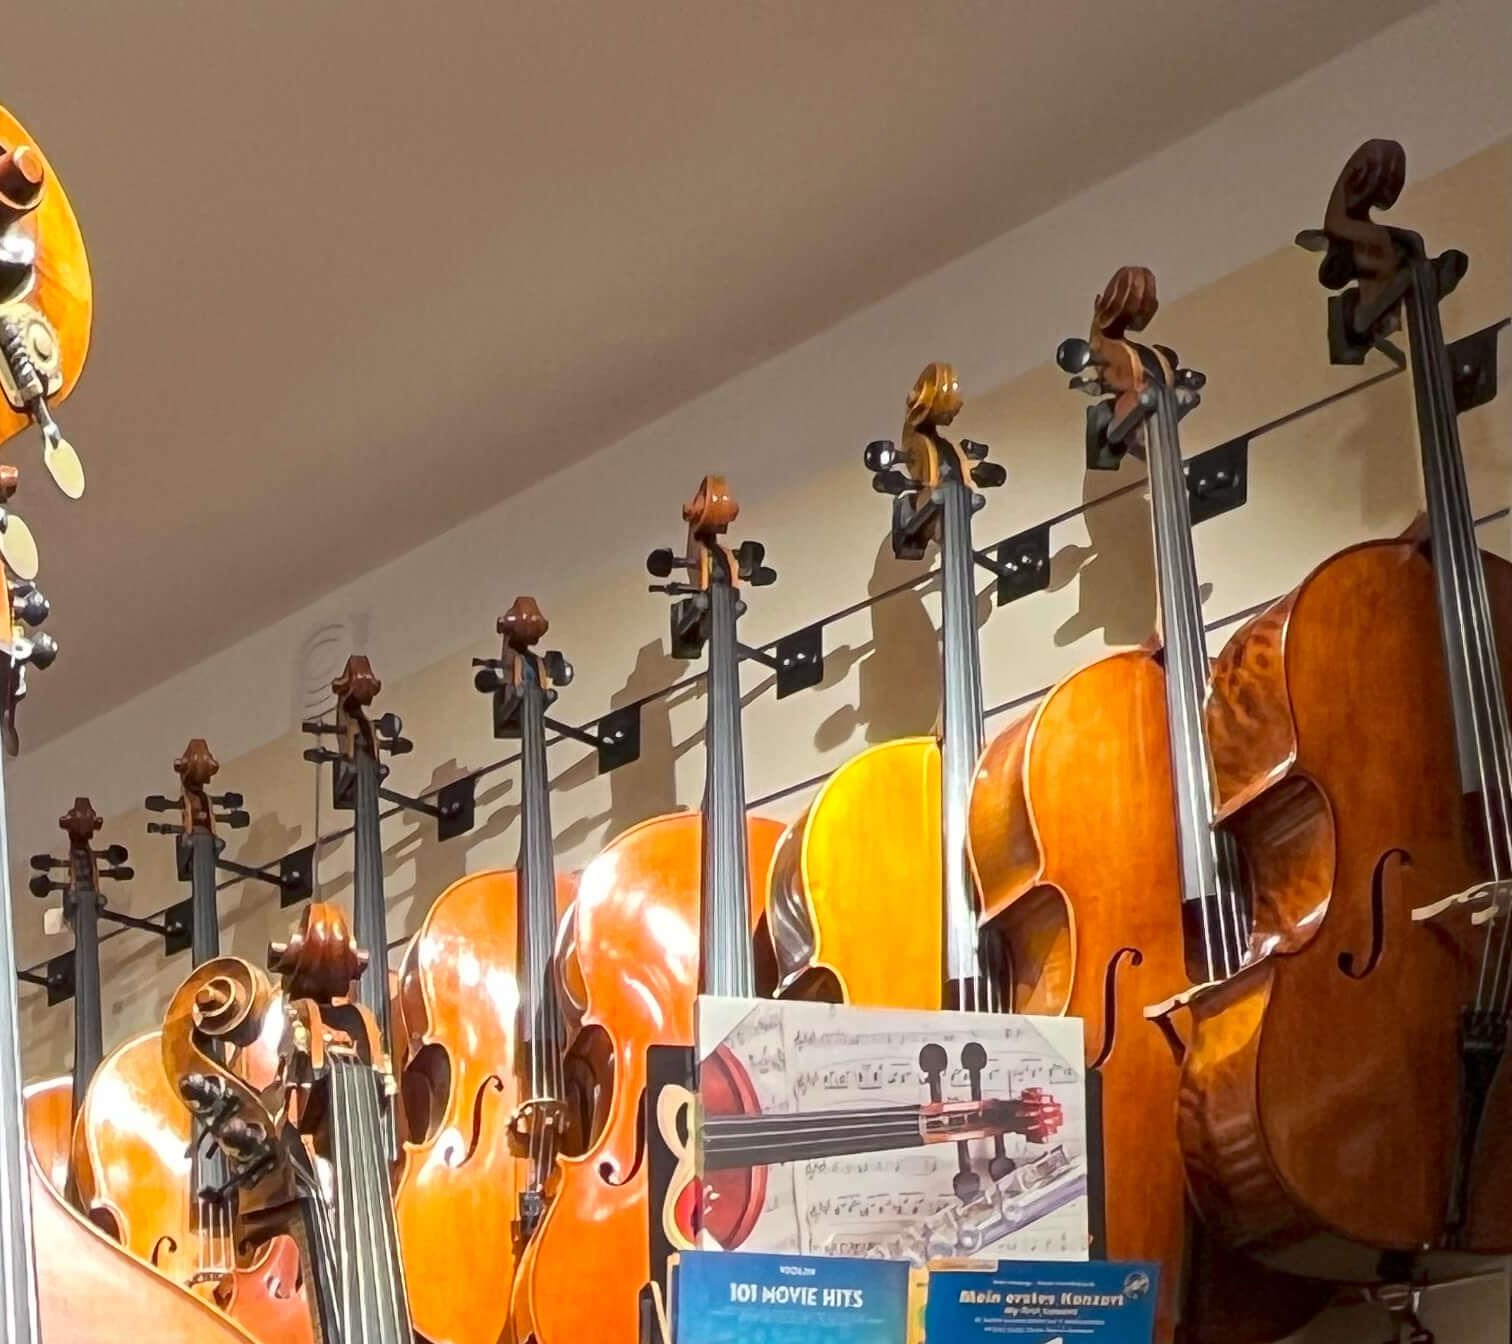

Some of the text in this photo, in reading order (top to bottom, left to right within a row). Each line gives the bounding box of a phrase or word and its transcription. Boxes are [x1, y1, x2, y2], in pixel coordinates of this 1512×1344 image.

[729, 1282, 863, 1309] 101 MOVIE HITS
[1061, 1292, 1124, 1307] Konzert
